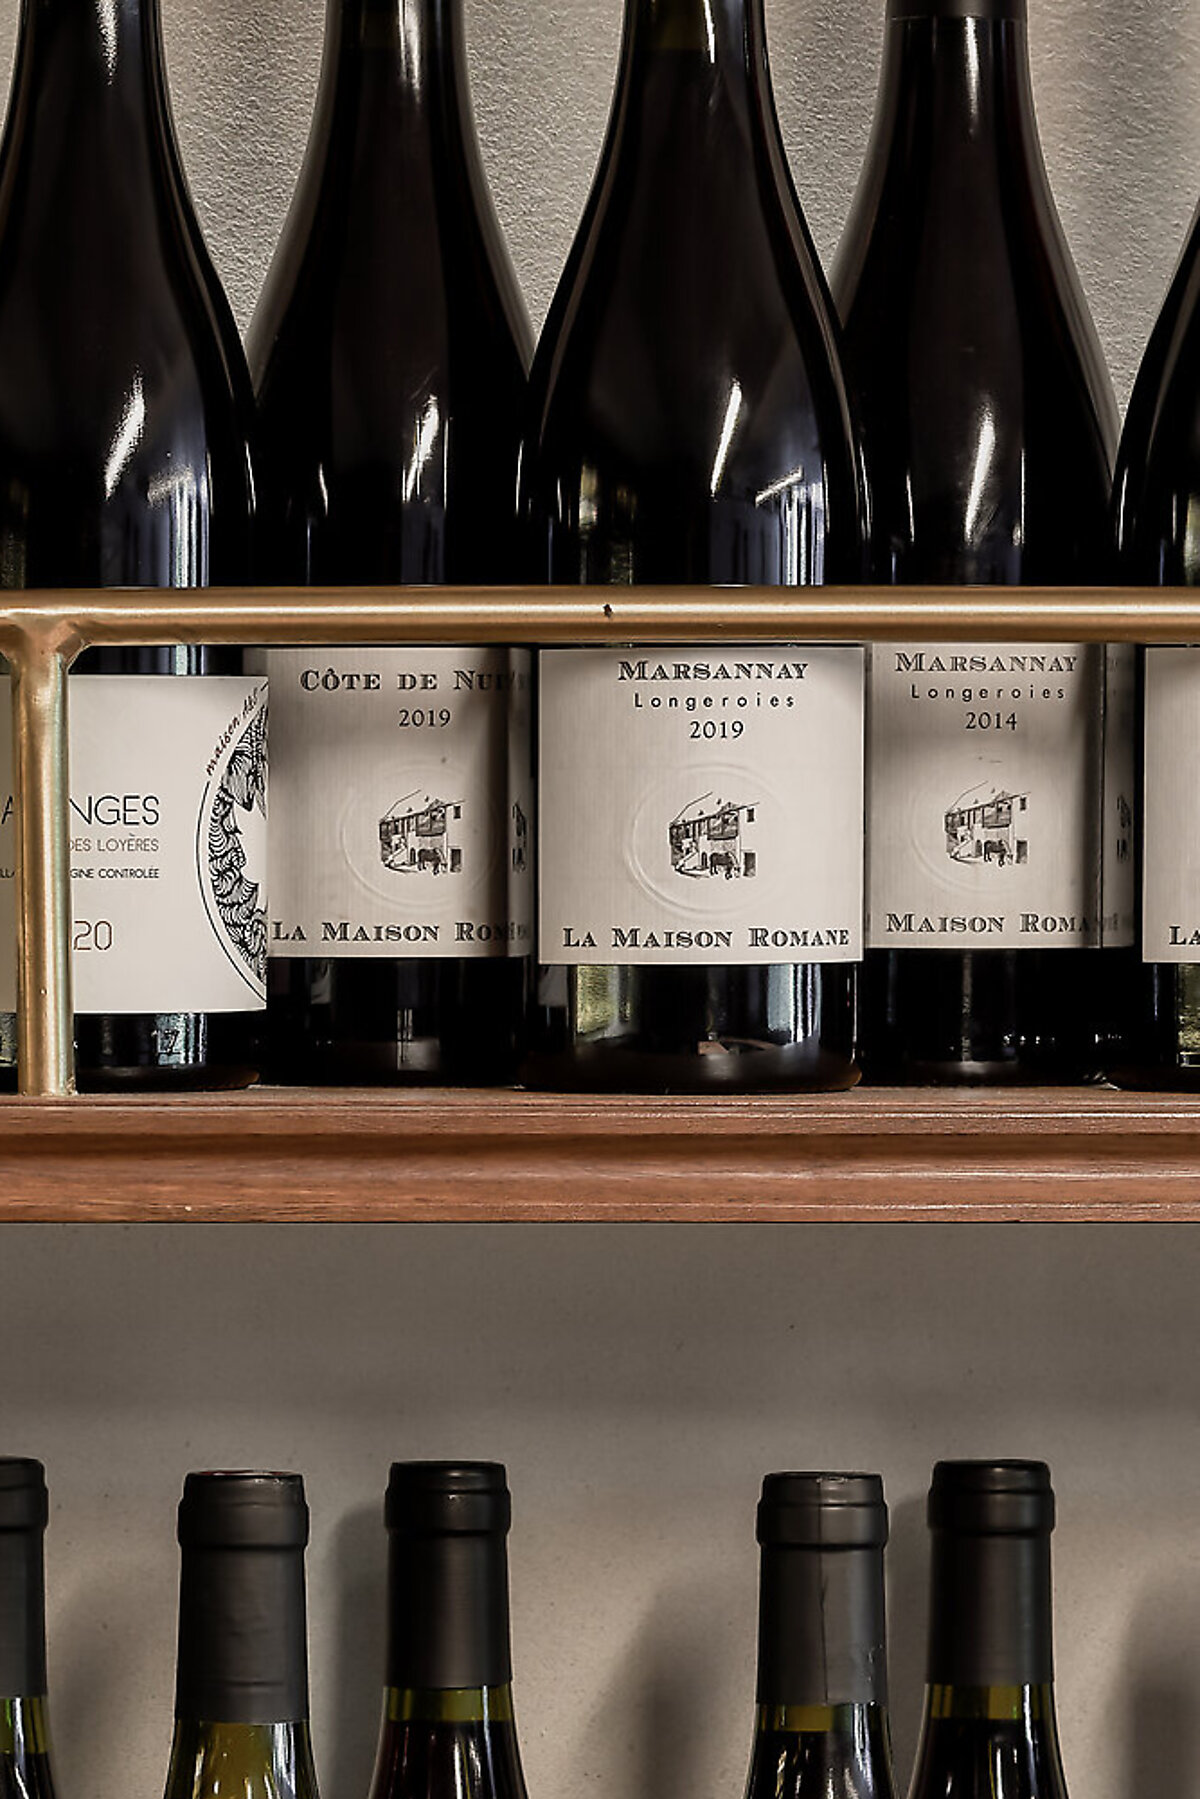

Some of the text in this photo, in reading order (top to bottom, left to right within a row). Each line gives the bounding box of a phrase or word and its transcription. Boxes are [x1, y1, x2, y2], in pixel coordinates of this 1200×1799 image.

[617, 660, 809, 682] MARSANNAY
[894, 652, 1078, 673] MARSANNAY
[300, 669, 382, 692] CÔTE
[397, 673, 439, 690] DE
[633, 692, 795, 712] Longeroies
[910, 684, 1066, 702] Longeroies
[399, 709, 451, 728] 2019
[965, 712, 1017, 731] 2014
[689, 721, 744, 739] 2019
[97, 833, 160, 852] LOYÈRES
[272, 921, 307, 942] LA
[321, 922, 441, 943] MAISON
[886, 913, 1006, 934] MAISON
[73, 920, 113, 951] 20
[562, 928, 850, 948] LA MAISON ROMANE
